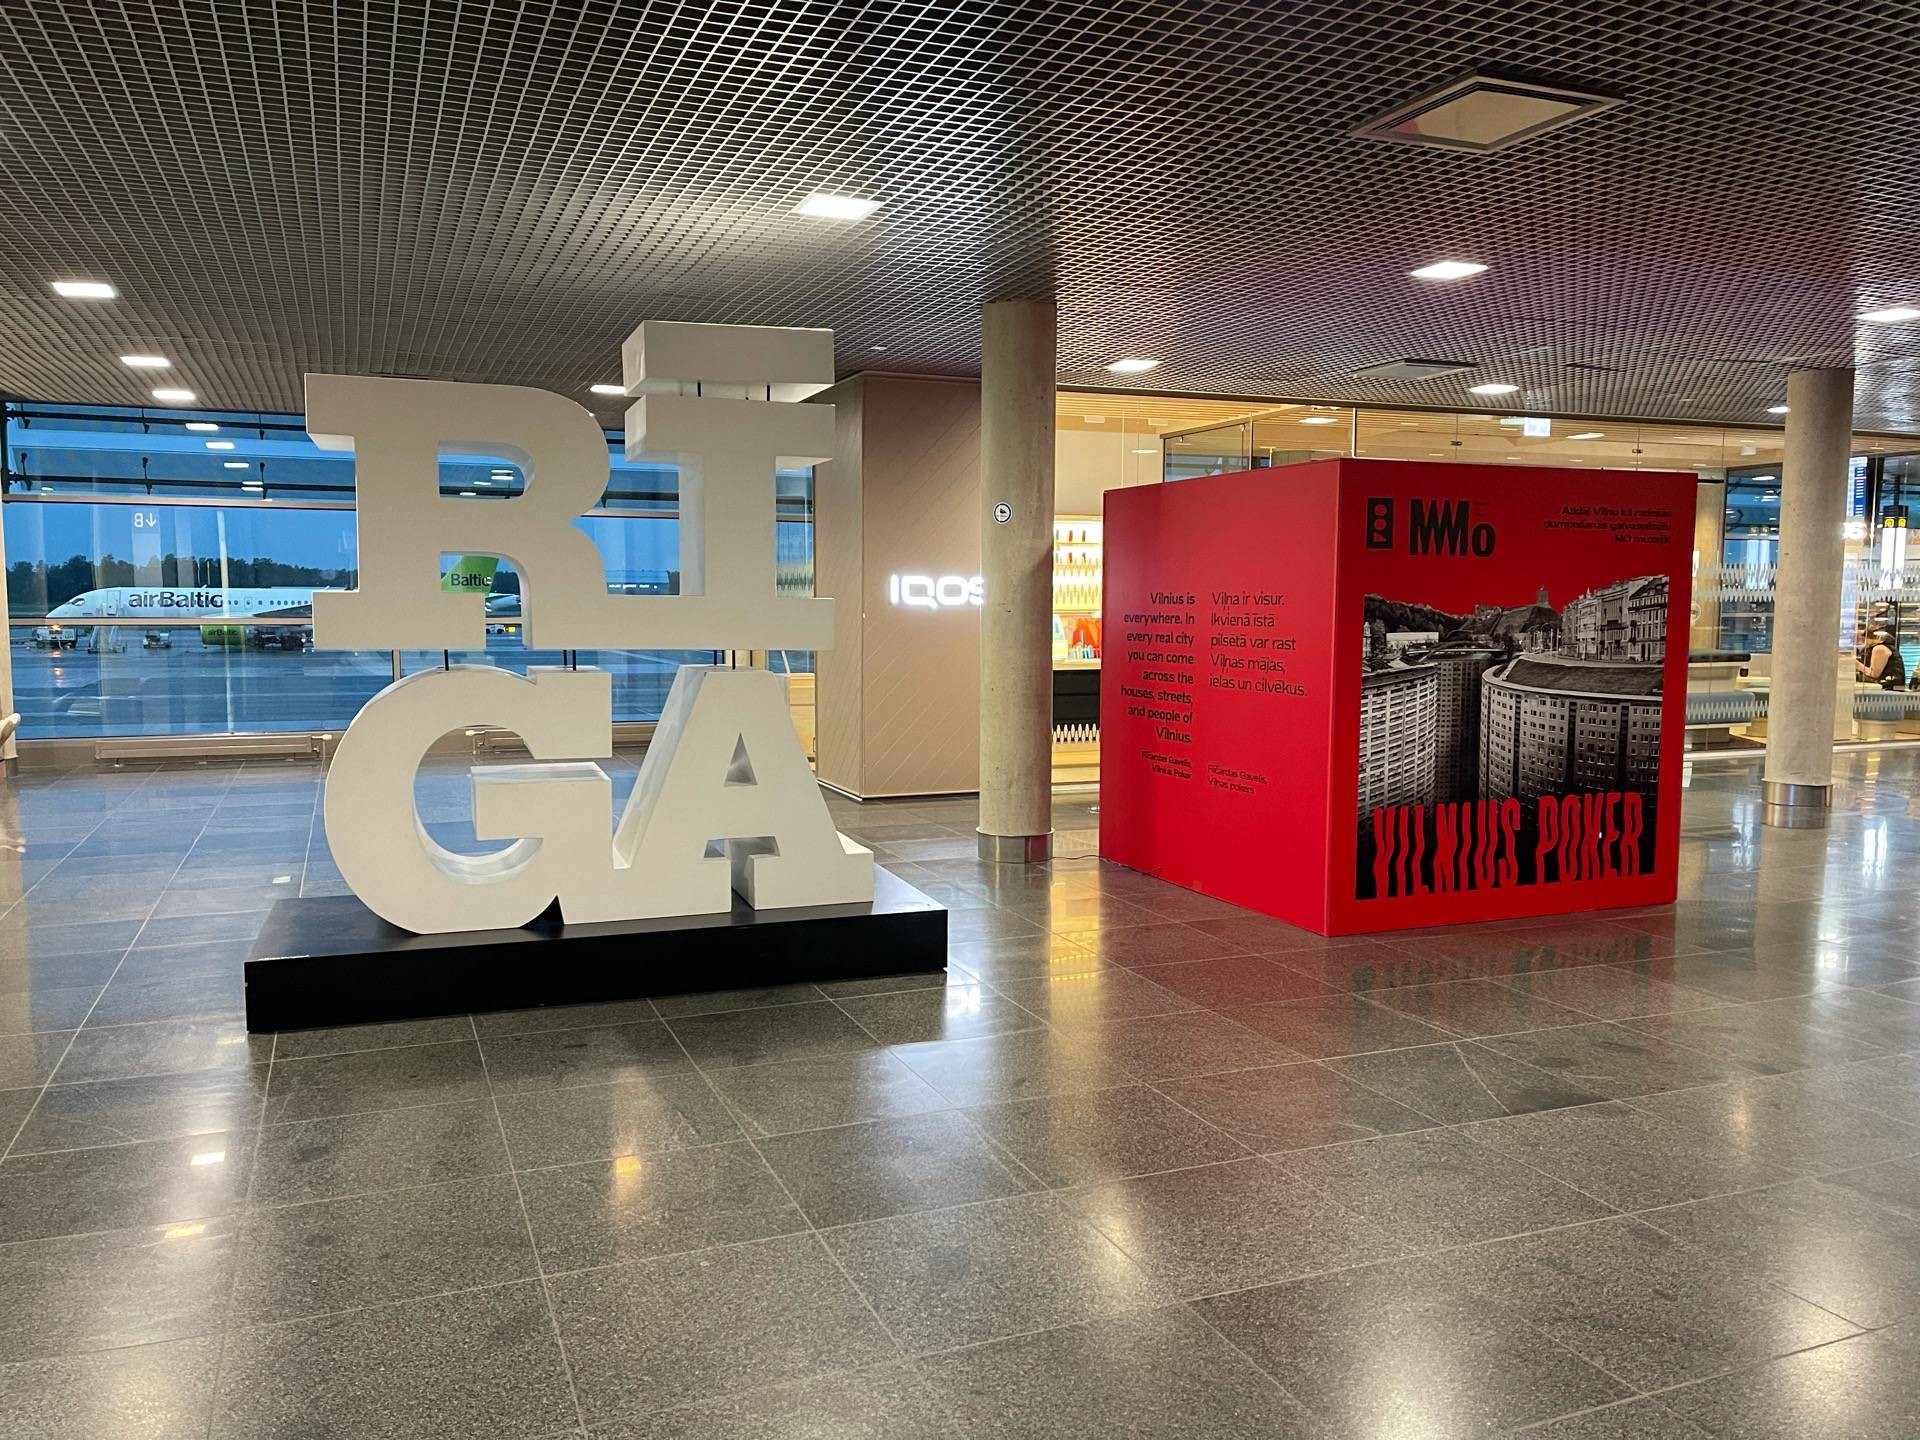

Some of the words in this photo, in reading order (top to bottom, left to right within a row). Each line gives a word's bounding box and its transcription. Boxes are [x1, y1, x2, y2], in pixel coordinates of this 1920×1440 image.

[128, 591, 224, 608] airBaltic
[1150, 592, 1184, 605] Vilnius
[1186, 591, 1195, 605] is
[1242, 591, 1250, 605] ir
[1253, 592, 1285, 606] visur.
[1124, 612, 1183, 626] everywhere.
[1185, 612, 1195, 625] In
[1211, 612, 1250, 627] Ikvienā
[1127, 633, 1152, 648] every
[1155, 632, 1174, 644] real
[1176, 633, 1194, 647] city
[1210, 633, 1246, 649] pilsētā
[1249, 638, 1269, 650] var
[1272, 637, 1296, 651] rast
[1128, 651, 1145, 663] you
[1147, 652, 1163, 663] can
[1166, 654, 1194, 665] come
[1248, 656, 1286, 673] mājas,
[1143, 670, 1174, 682] across
[1177, 671, 1194, 685] the
[1209, 674, 1235, 689] ielas
[1238, 679, 1252, 691] un
[1255, 677, 1308, 697] cilvēkus.
[1121, 685, 1155, 701] houses,
[1157, 689, 1193, 707] streets,
[1128, 705, 1145, 717] and
[1148, 708, 1180, 724] people
[1183, 711, 1193, 724] of
[1156, 726, 1193, 743] Vilnius.
[1373, 797, 1520, 899] VILNIUS
[1536, 792, 1644, 885] POKER
